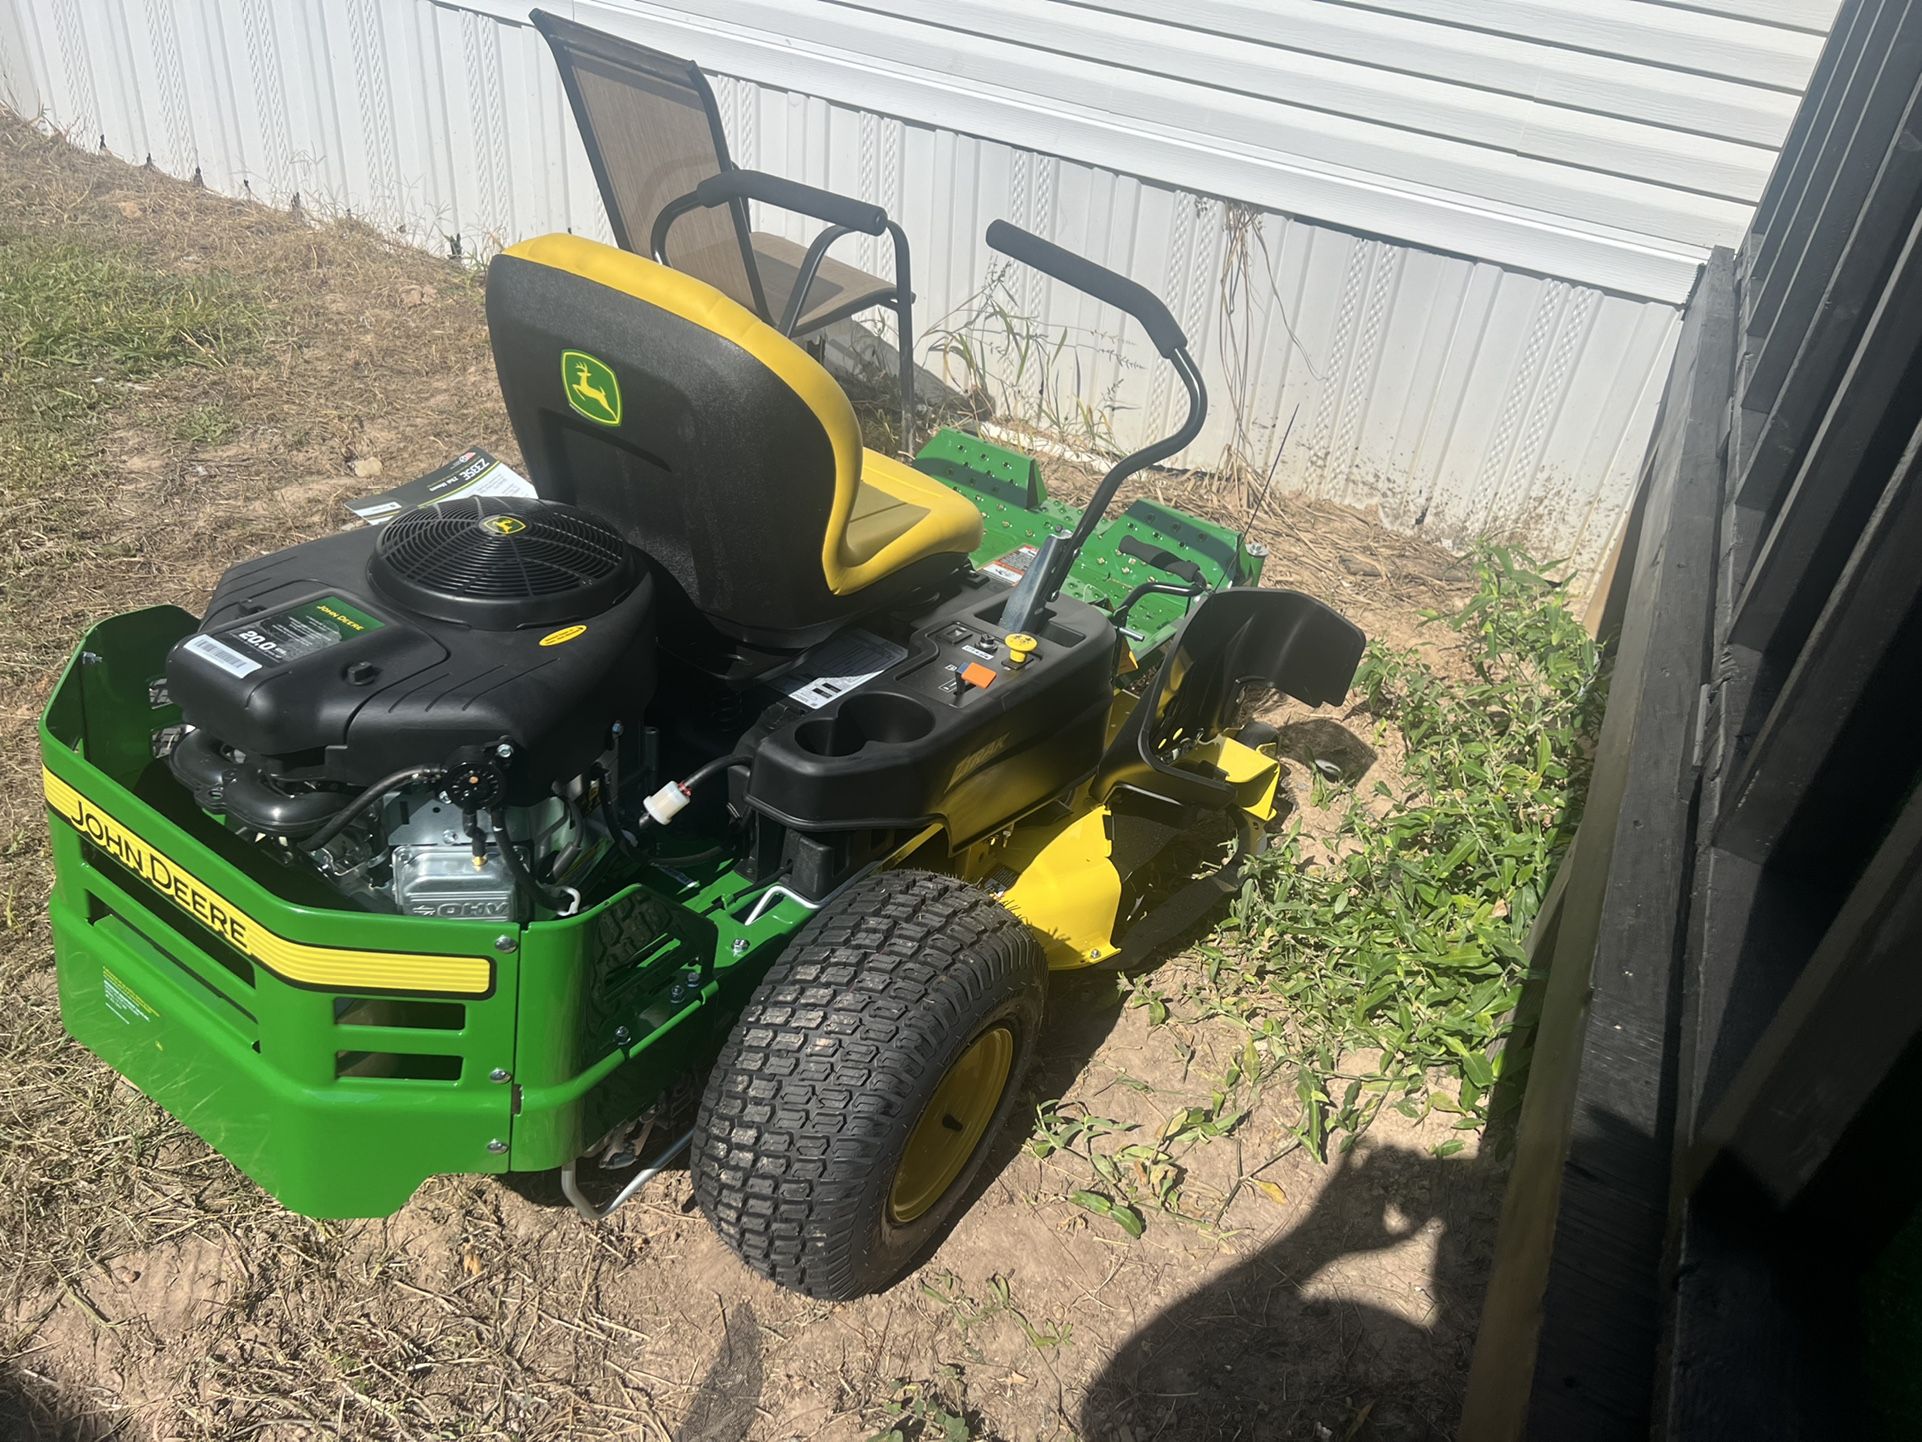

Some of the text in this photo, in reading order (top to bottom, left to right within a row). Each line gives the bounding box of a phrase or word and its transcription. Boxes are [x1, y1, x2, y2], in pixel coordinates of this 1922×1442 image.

[317, 605, 338, 618] JOHN
[337, 614, 365, 631] DEERE
[239, 630, 276, 651] 20.0
[71, 800, 249, 949] JOHN DEERE
